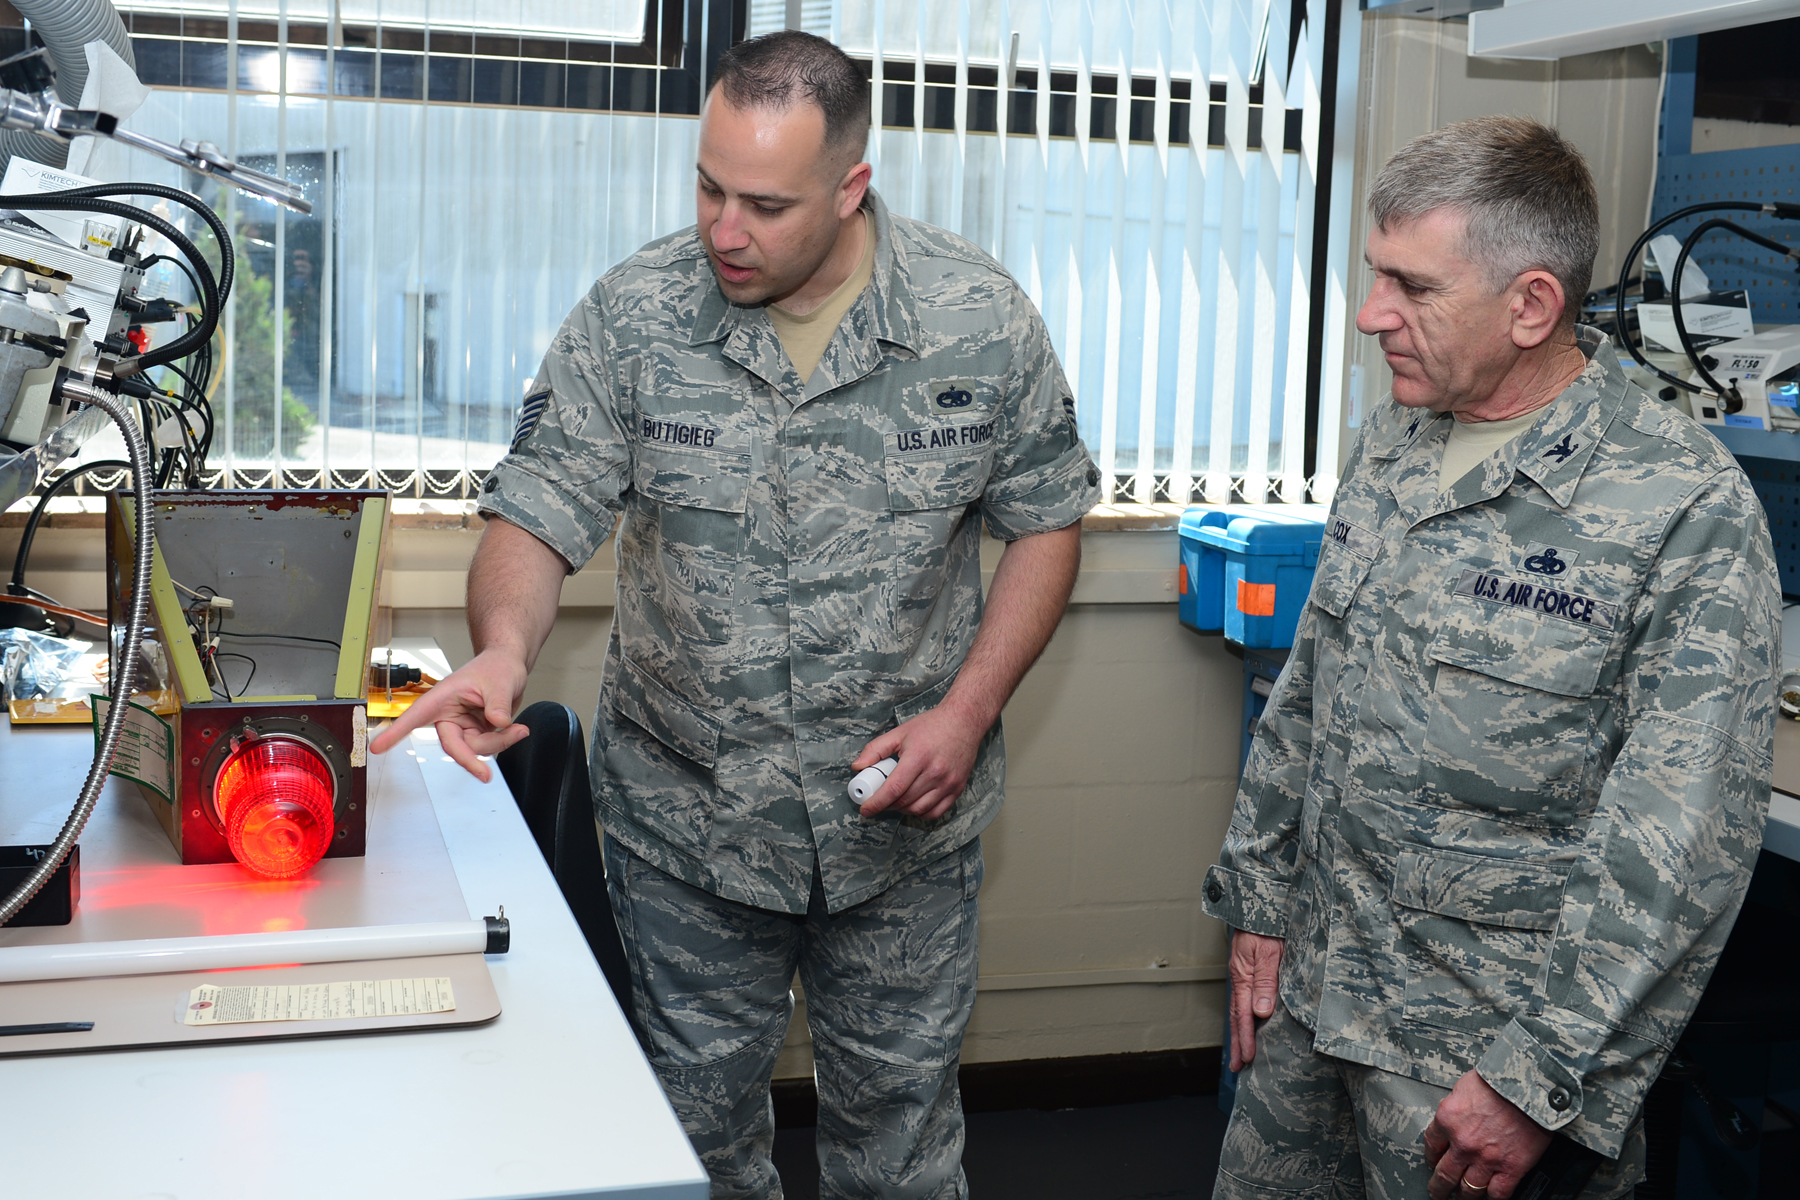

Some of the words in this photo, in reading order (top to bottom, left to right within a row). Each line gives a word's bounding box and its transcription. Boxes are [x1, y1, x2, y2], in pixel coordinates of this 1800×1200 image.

[41, 172, 78, 187] KIMTECH
[643, 418, 715, 447] BUTIGIEG
[897, 431, 927, 451] U.S.
[930, 427, 958, 448] AIR
[1333, 520, 1351, 544] COX
[1474, 574, 1499, 599] U.S.
[1503, 582, 1532, 607] AIR
[1533, 588, 1595, 622] FORCE
